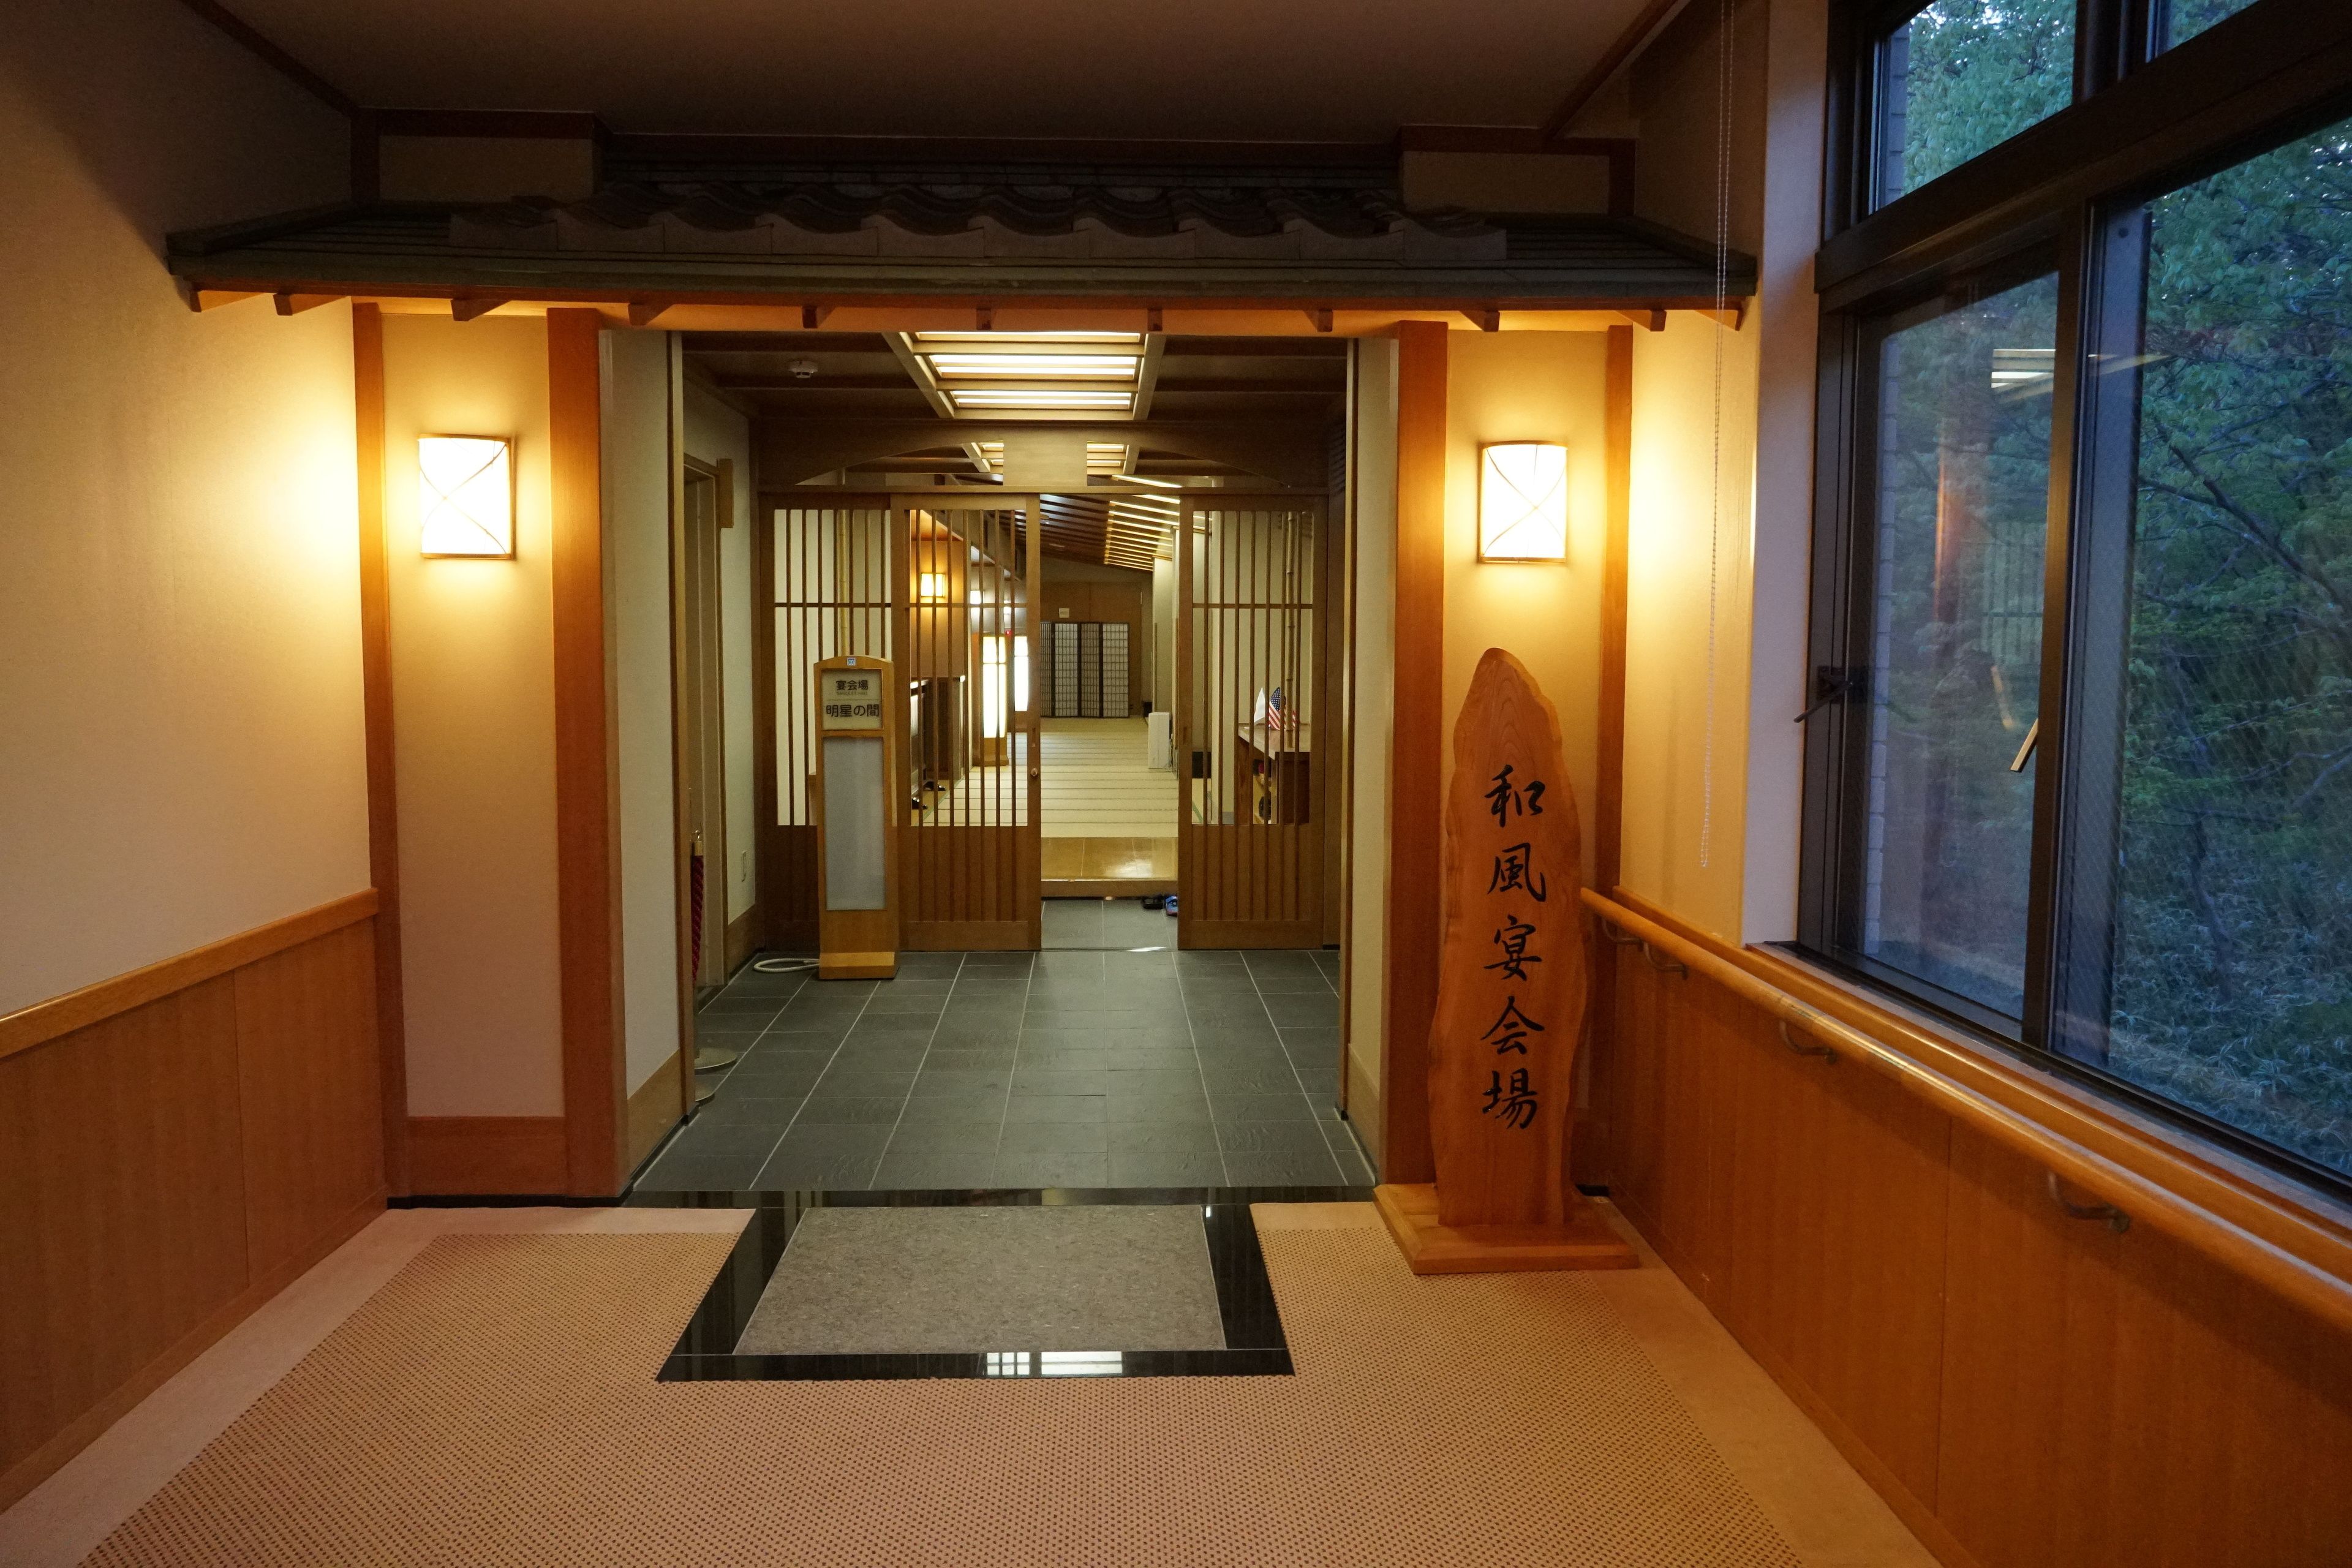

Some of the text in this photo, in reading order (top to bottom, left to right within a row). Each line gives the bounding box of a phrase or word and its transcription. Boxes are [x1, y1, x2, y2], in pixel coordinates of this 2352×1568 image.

[835, 680, 869, 690] 宴会場
[826, 704, 880, 717] 明星の間
[1481, 764, 1547, 1129] 和風宴会場
